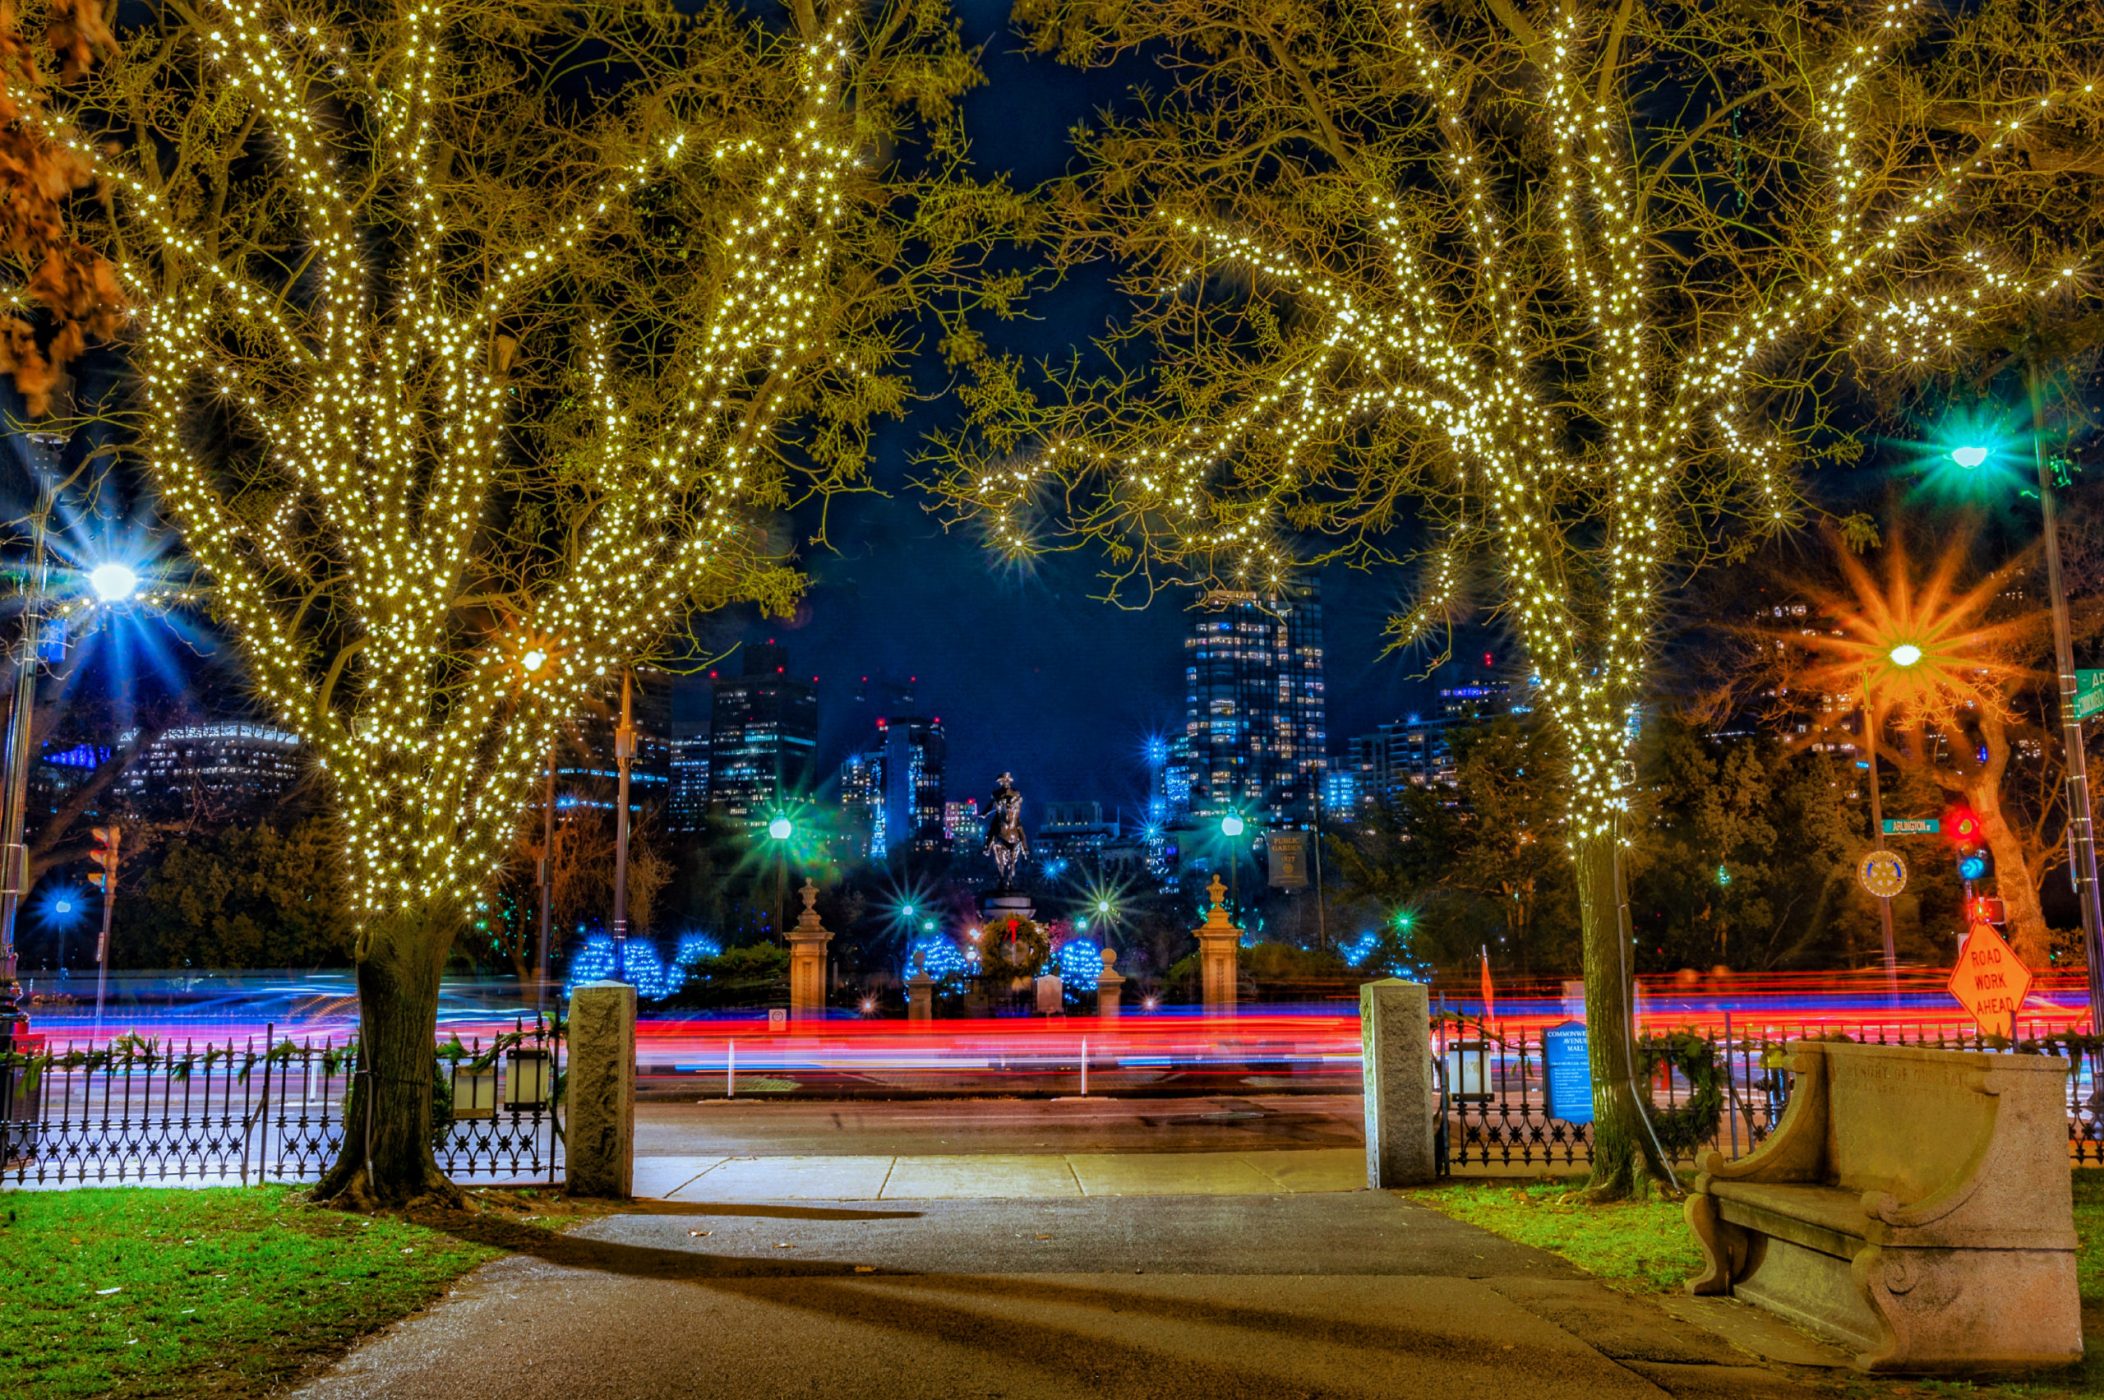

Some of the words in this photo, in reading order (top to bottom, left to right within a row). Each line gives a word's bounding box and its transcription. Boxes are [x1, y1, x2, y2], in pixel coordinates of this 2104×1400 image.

[1971, 949, 2002, 966] ROAD
[1974, 972, 2007, 990] WORK
[1976, 997, 2014, 1015] AHEAD
